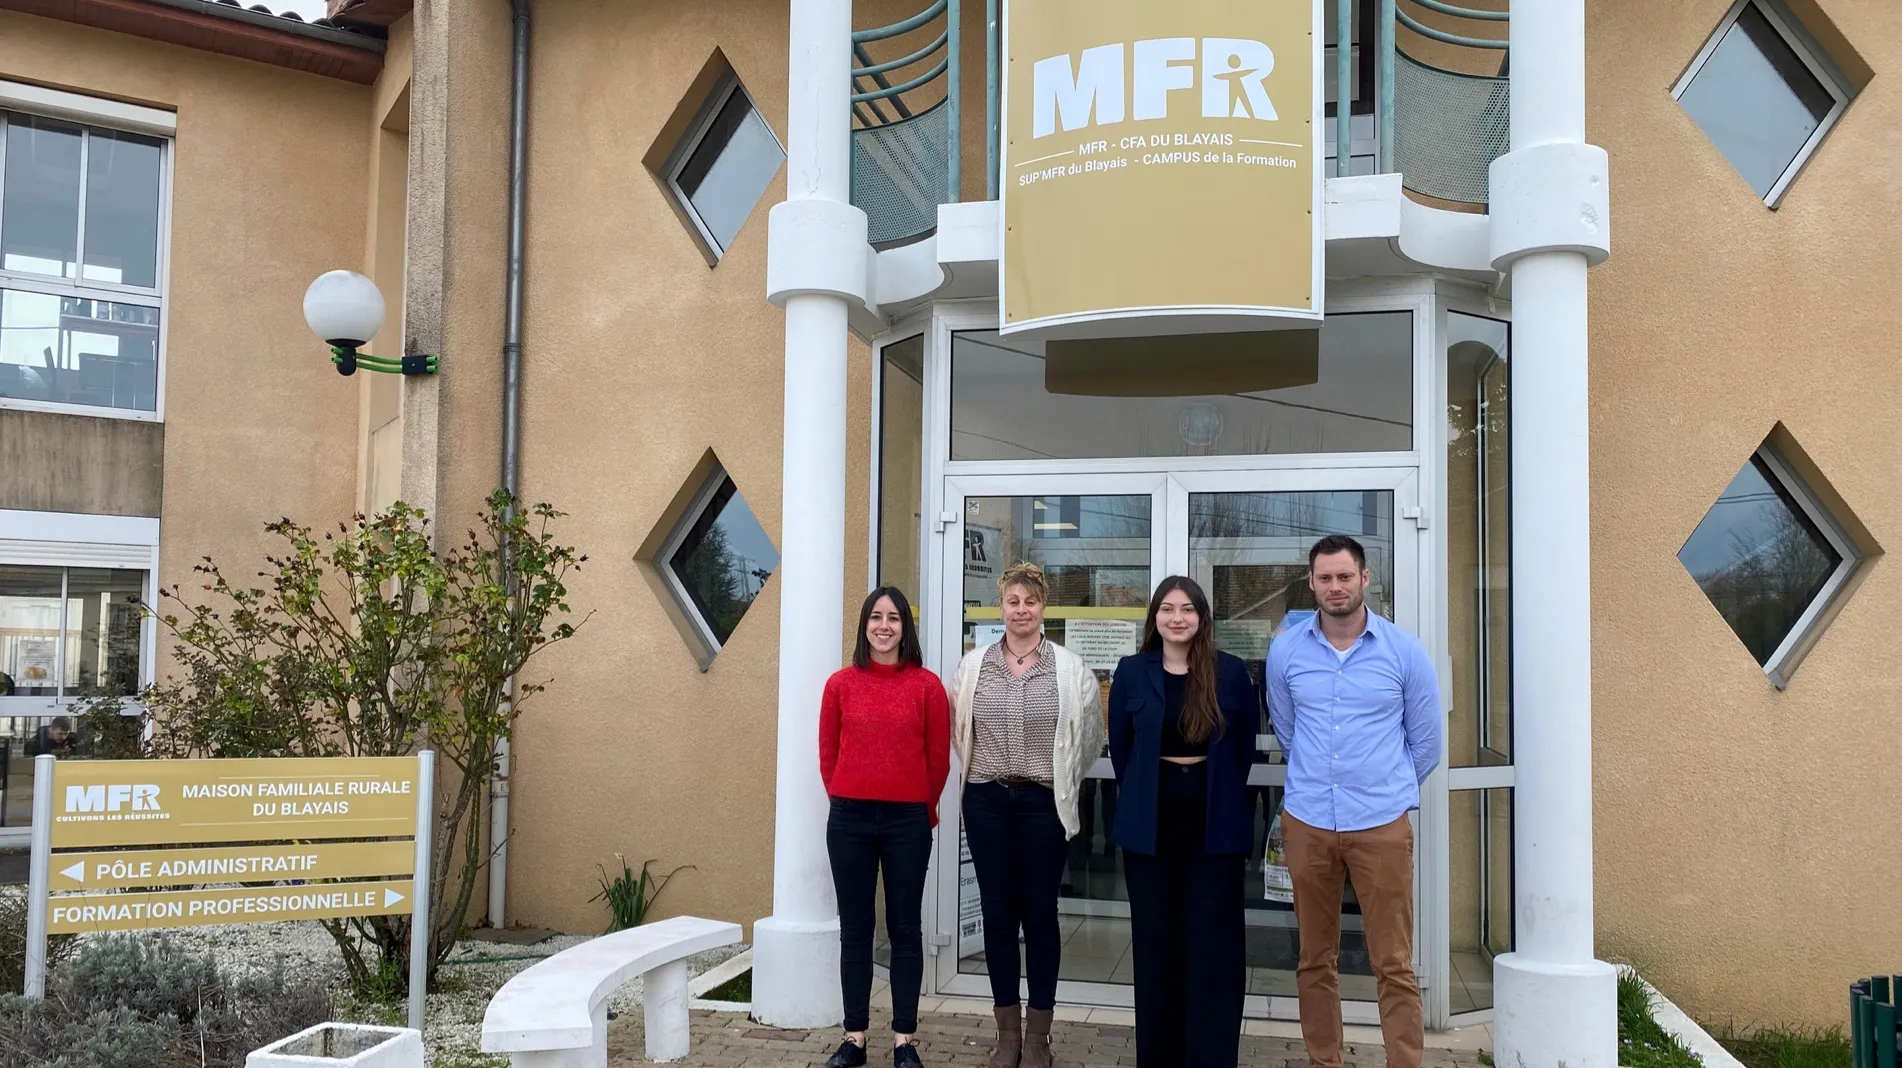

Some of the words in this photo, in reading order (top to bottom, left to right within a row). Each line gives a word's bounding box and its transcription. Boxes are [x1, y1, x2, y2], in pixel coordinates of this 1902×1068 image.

[1032, 36, 1279, 139] MFR
[1079, 140, 1108, 156] MFR
[1120, 136, 1147, 149] CFA
[1150, 134, 1170, 147] DU
[1174, 133, 1233, 146] BLAYAIS
[1019, 166, 1066, 186] SUP'MFR
[1068, 163, 1082, 175] du
[1085, 156, 1128, 172] Blayais
[1143, 152, 1201, 165] CAMPUS
[1204, 152, 1220, 163] de
[1223, 152, 1234, 163] la
[1237, 152, 1297, 168] Formation
[65, 784, 161, 813] MFR
[182, 783, 253, 799] MAISON
[258, 782, 344, 797] FAMILIALE
[348, 781, 411, 795] RURALE
[56, 815, 105, 823] CULTIVONS
[124, 812, 171, 820] RÉUSSITES
[253, 803, 276, 817] DU
[280, 801, 349, 816] BLAYAIS
[96, 859, 153, 880] PÔLE
[157, 855, 318, 878] ADMINISTRATIF
[53, 901, 183, 924] FORMATION
[188, 891, 376, 917] PROFESSIONNELLE
